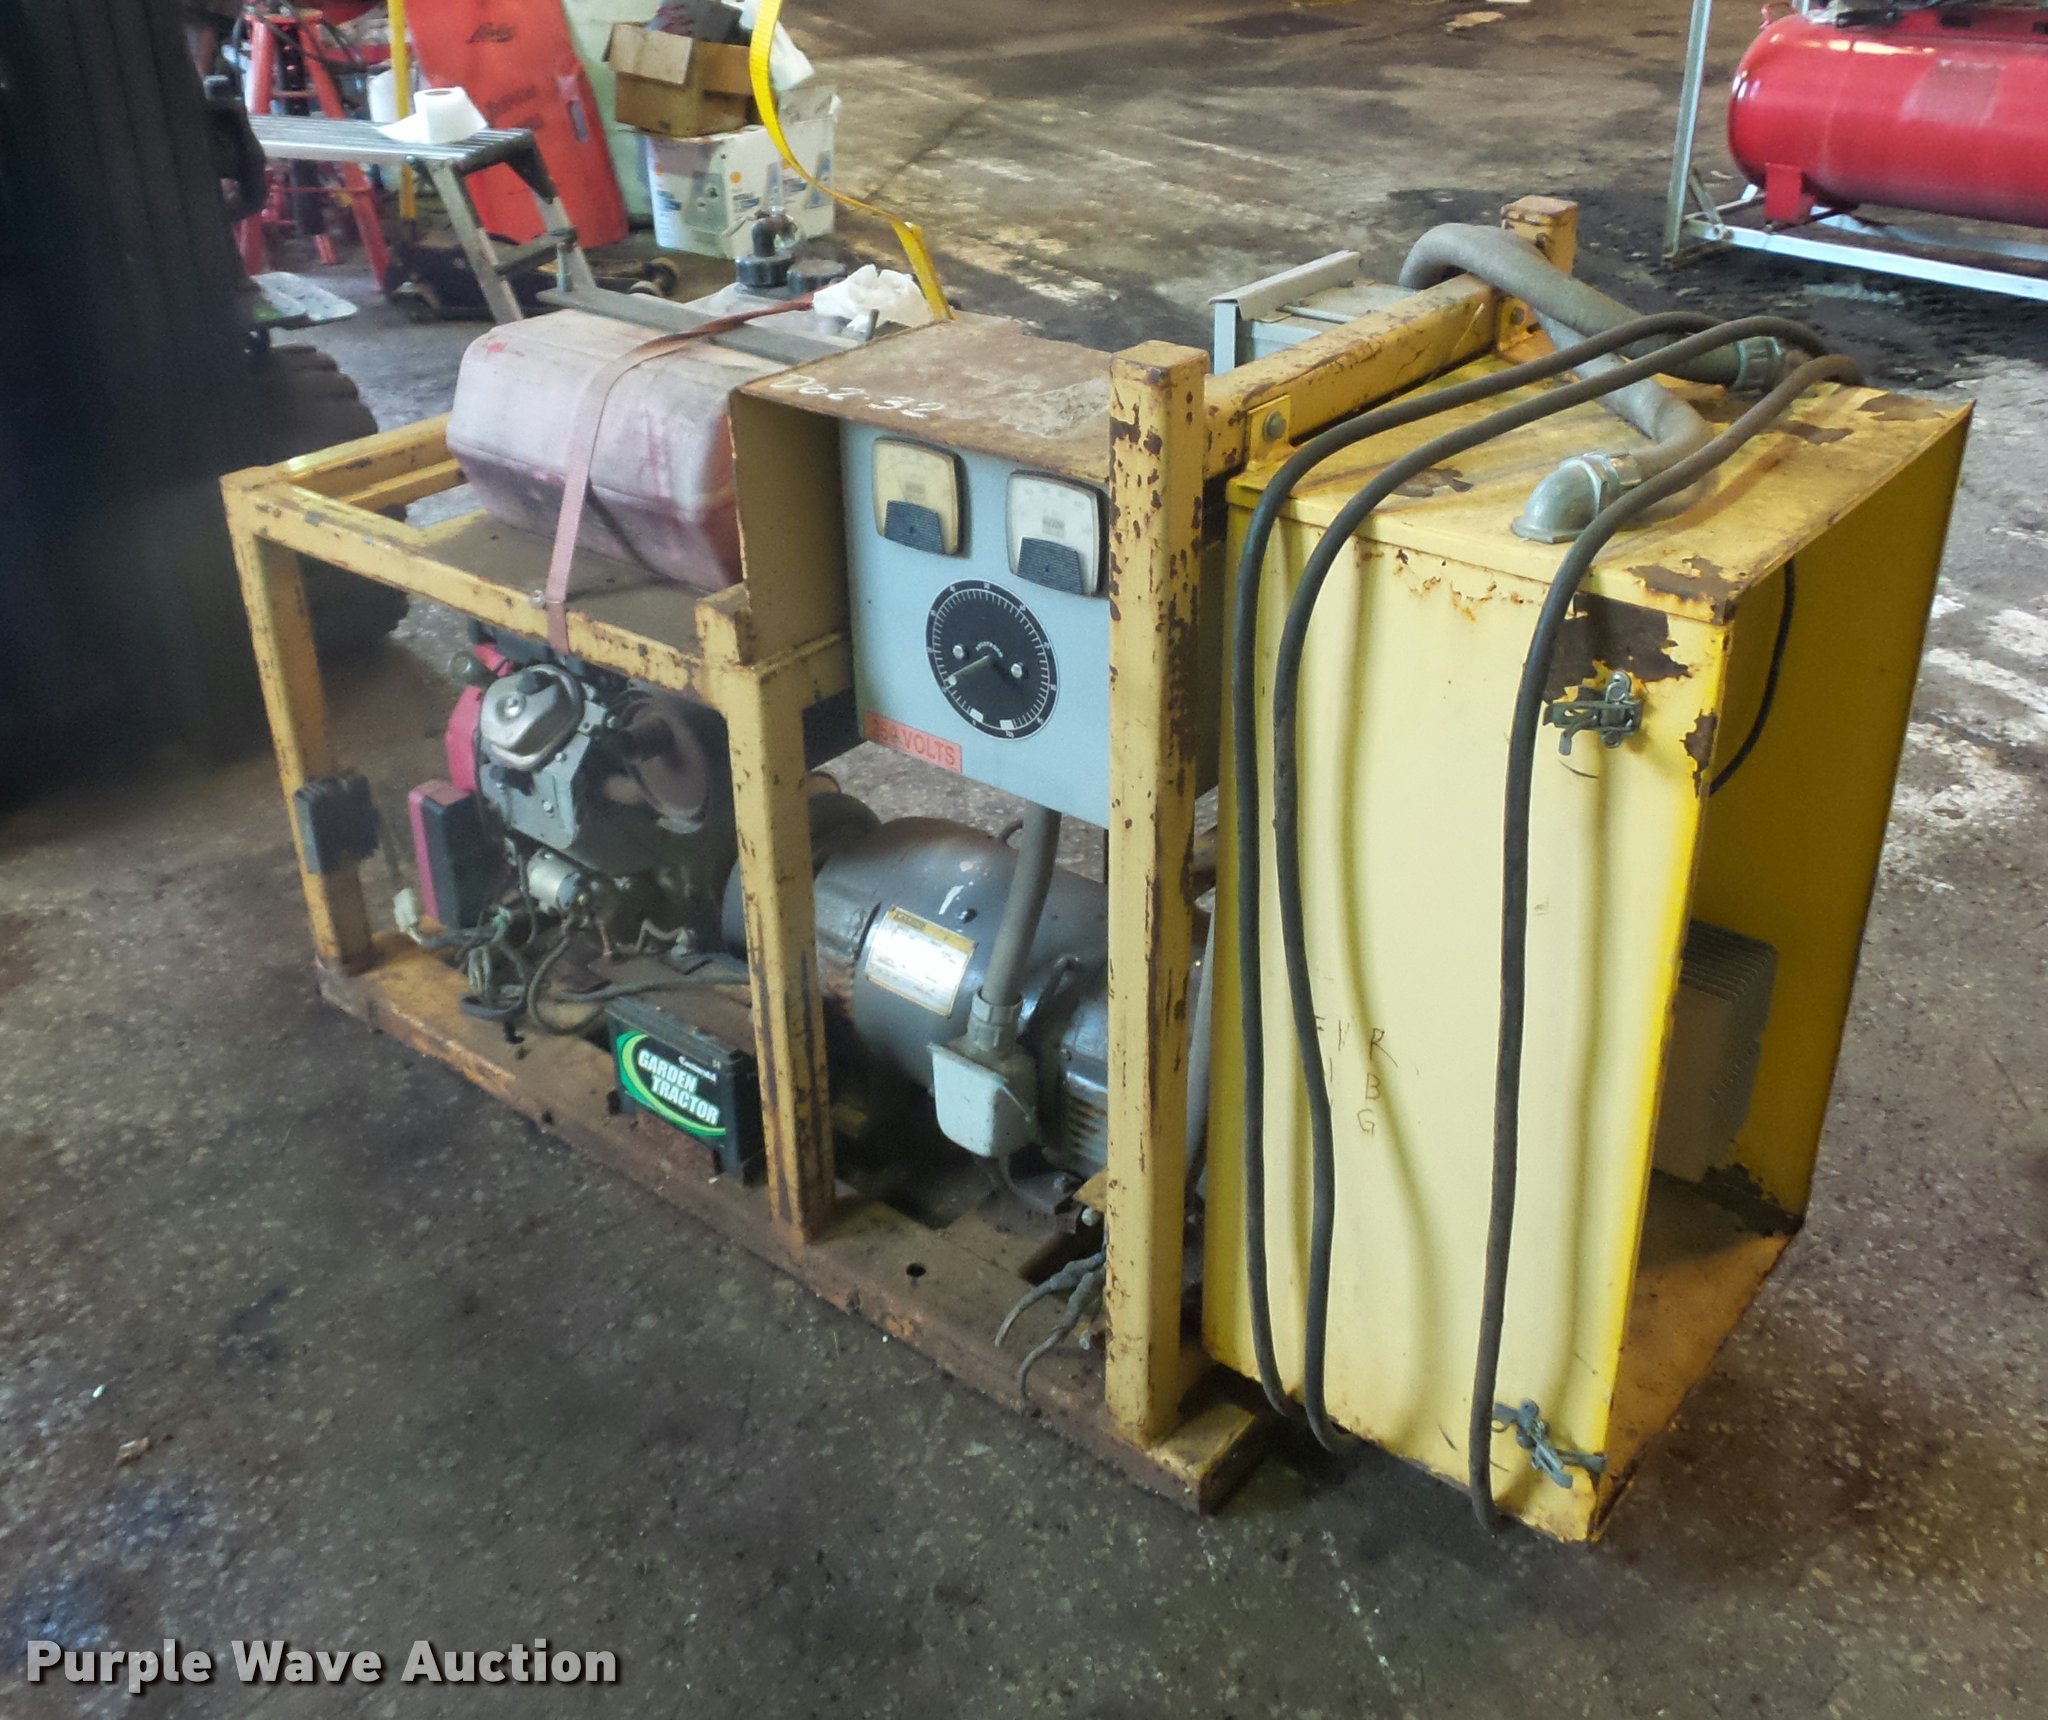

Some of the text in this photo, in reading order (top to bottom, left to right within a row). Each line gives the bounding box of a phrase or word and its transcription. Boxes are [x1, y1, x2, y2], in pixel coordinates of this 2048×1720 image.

[899, 730, 955, 766] VOLTS
[1369, 1027, 1399, 1068] R
[637, 1049, 698, 1093] GARDEN
[1365, 1072, 1381, 1100] B
[650, 1076, 720, 1127] TRACTOR
[1356, 1108, 1376, 1136] G
